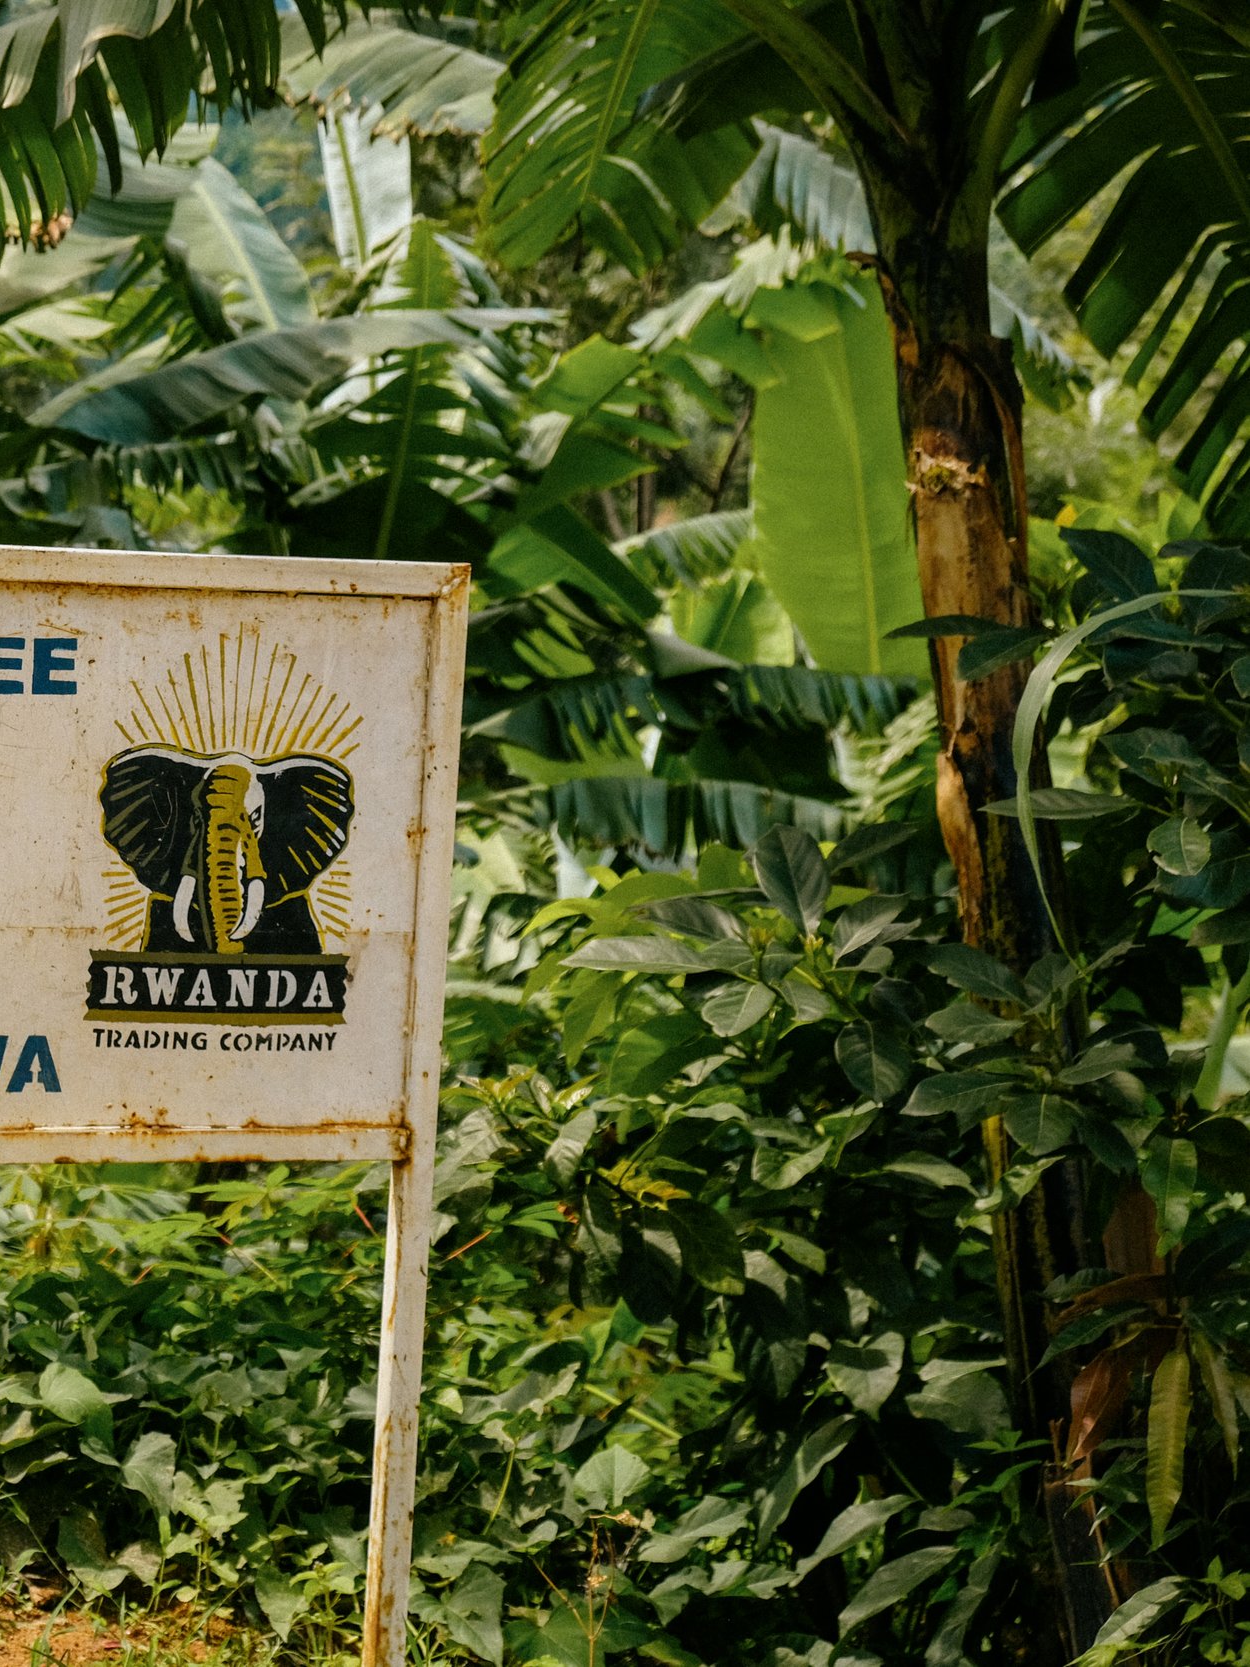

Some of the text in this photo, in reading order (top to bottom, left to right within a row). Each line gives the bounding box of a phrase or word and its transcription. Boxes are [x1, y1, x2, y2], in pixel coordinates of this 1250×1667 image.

[100, 966, 333, 1007] RWANDA
[94, 1028, 337, 1051] TRADING COMPANY
